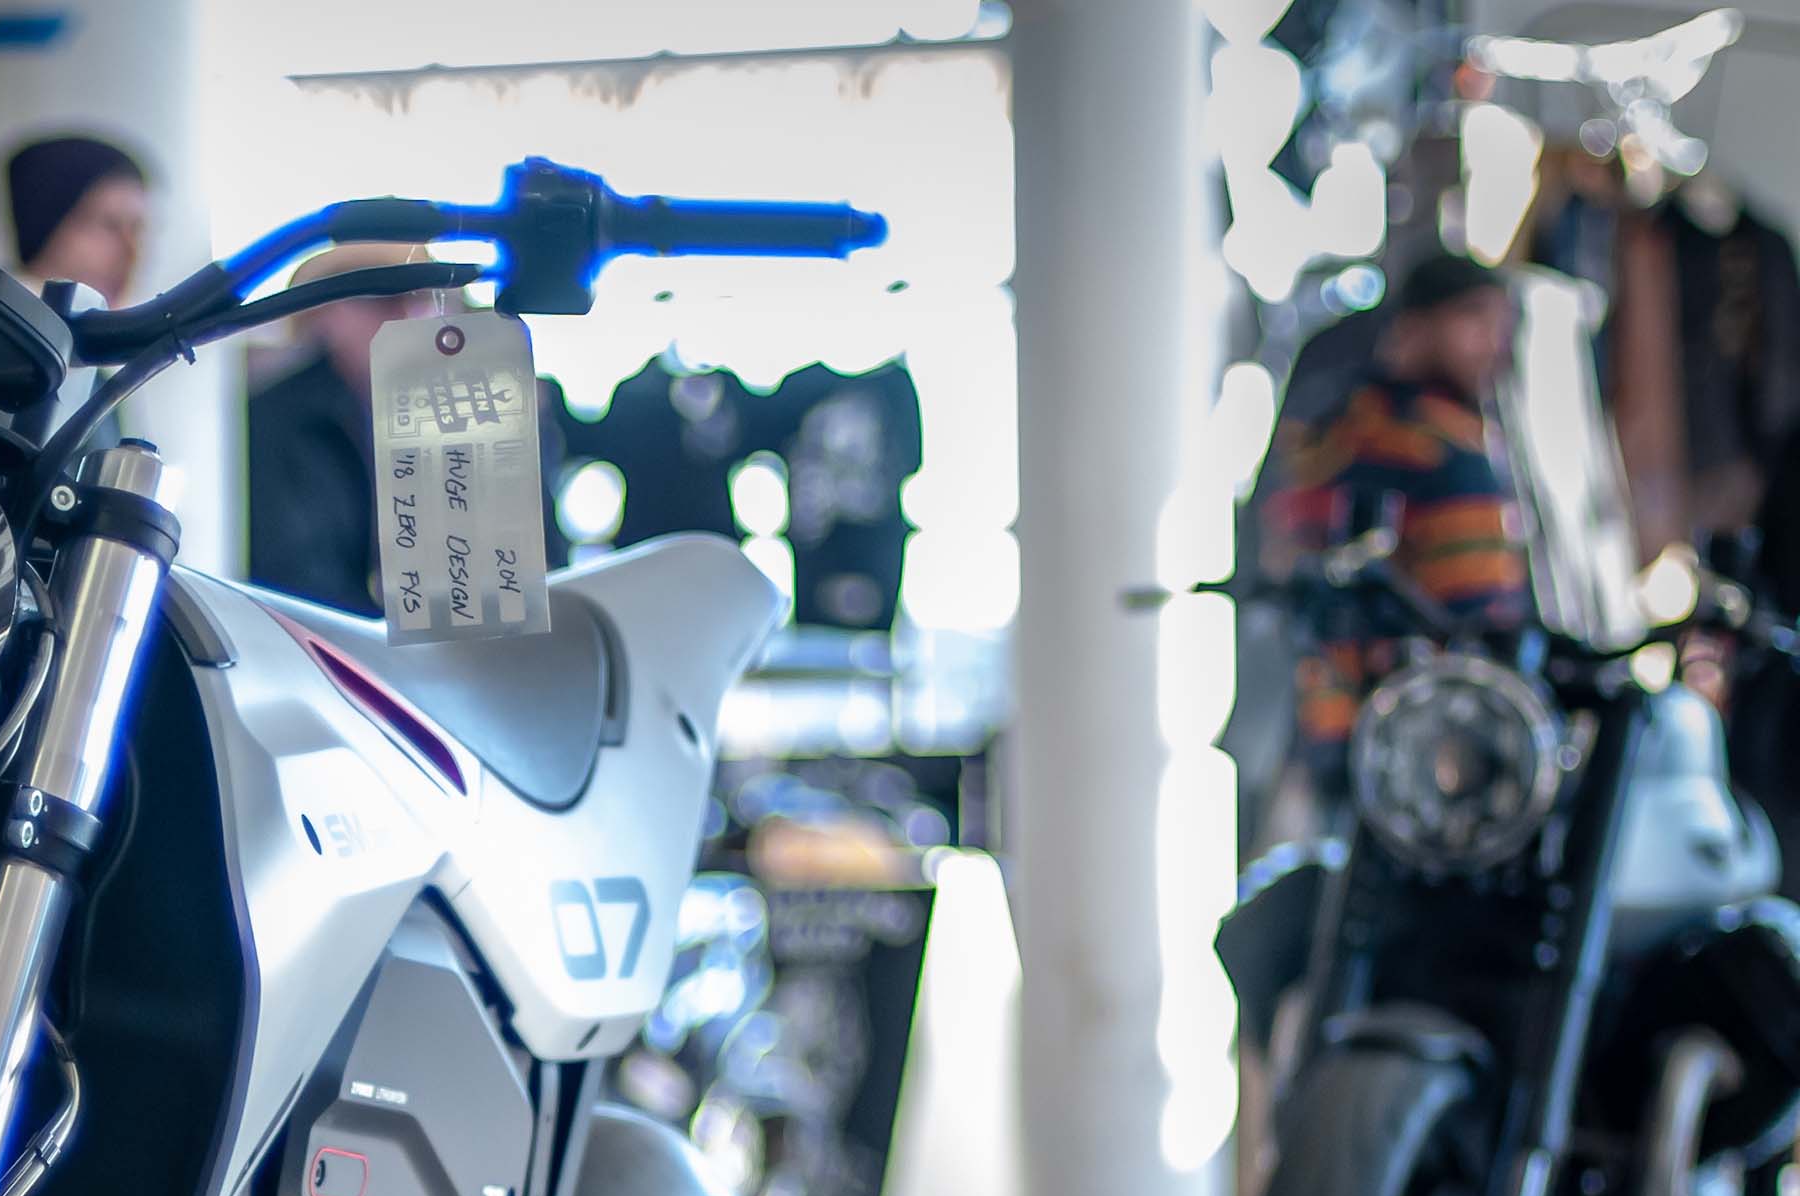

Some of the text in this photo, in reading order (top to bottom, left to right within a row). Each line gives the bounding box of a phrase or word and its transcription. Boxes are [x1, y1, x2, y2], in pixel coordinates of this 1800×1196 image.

[472, 382, 490, 411] TEN
[393, 495, 418, 549] ZERO
[444, 449, 475, 620] HUGE DESIGN
[400, 570, 421, 614] FXS
[495, 549, 521, 594] 204
[549, 876, 651, 980] 07
